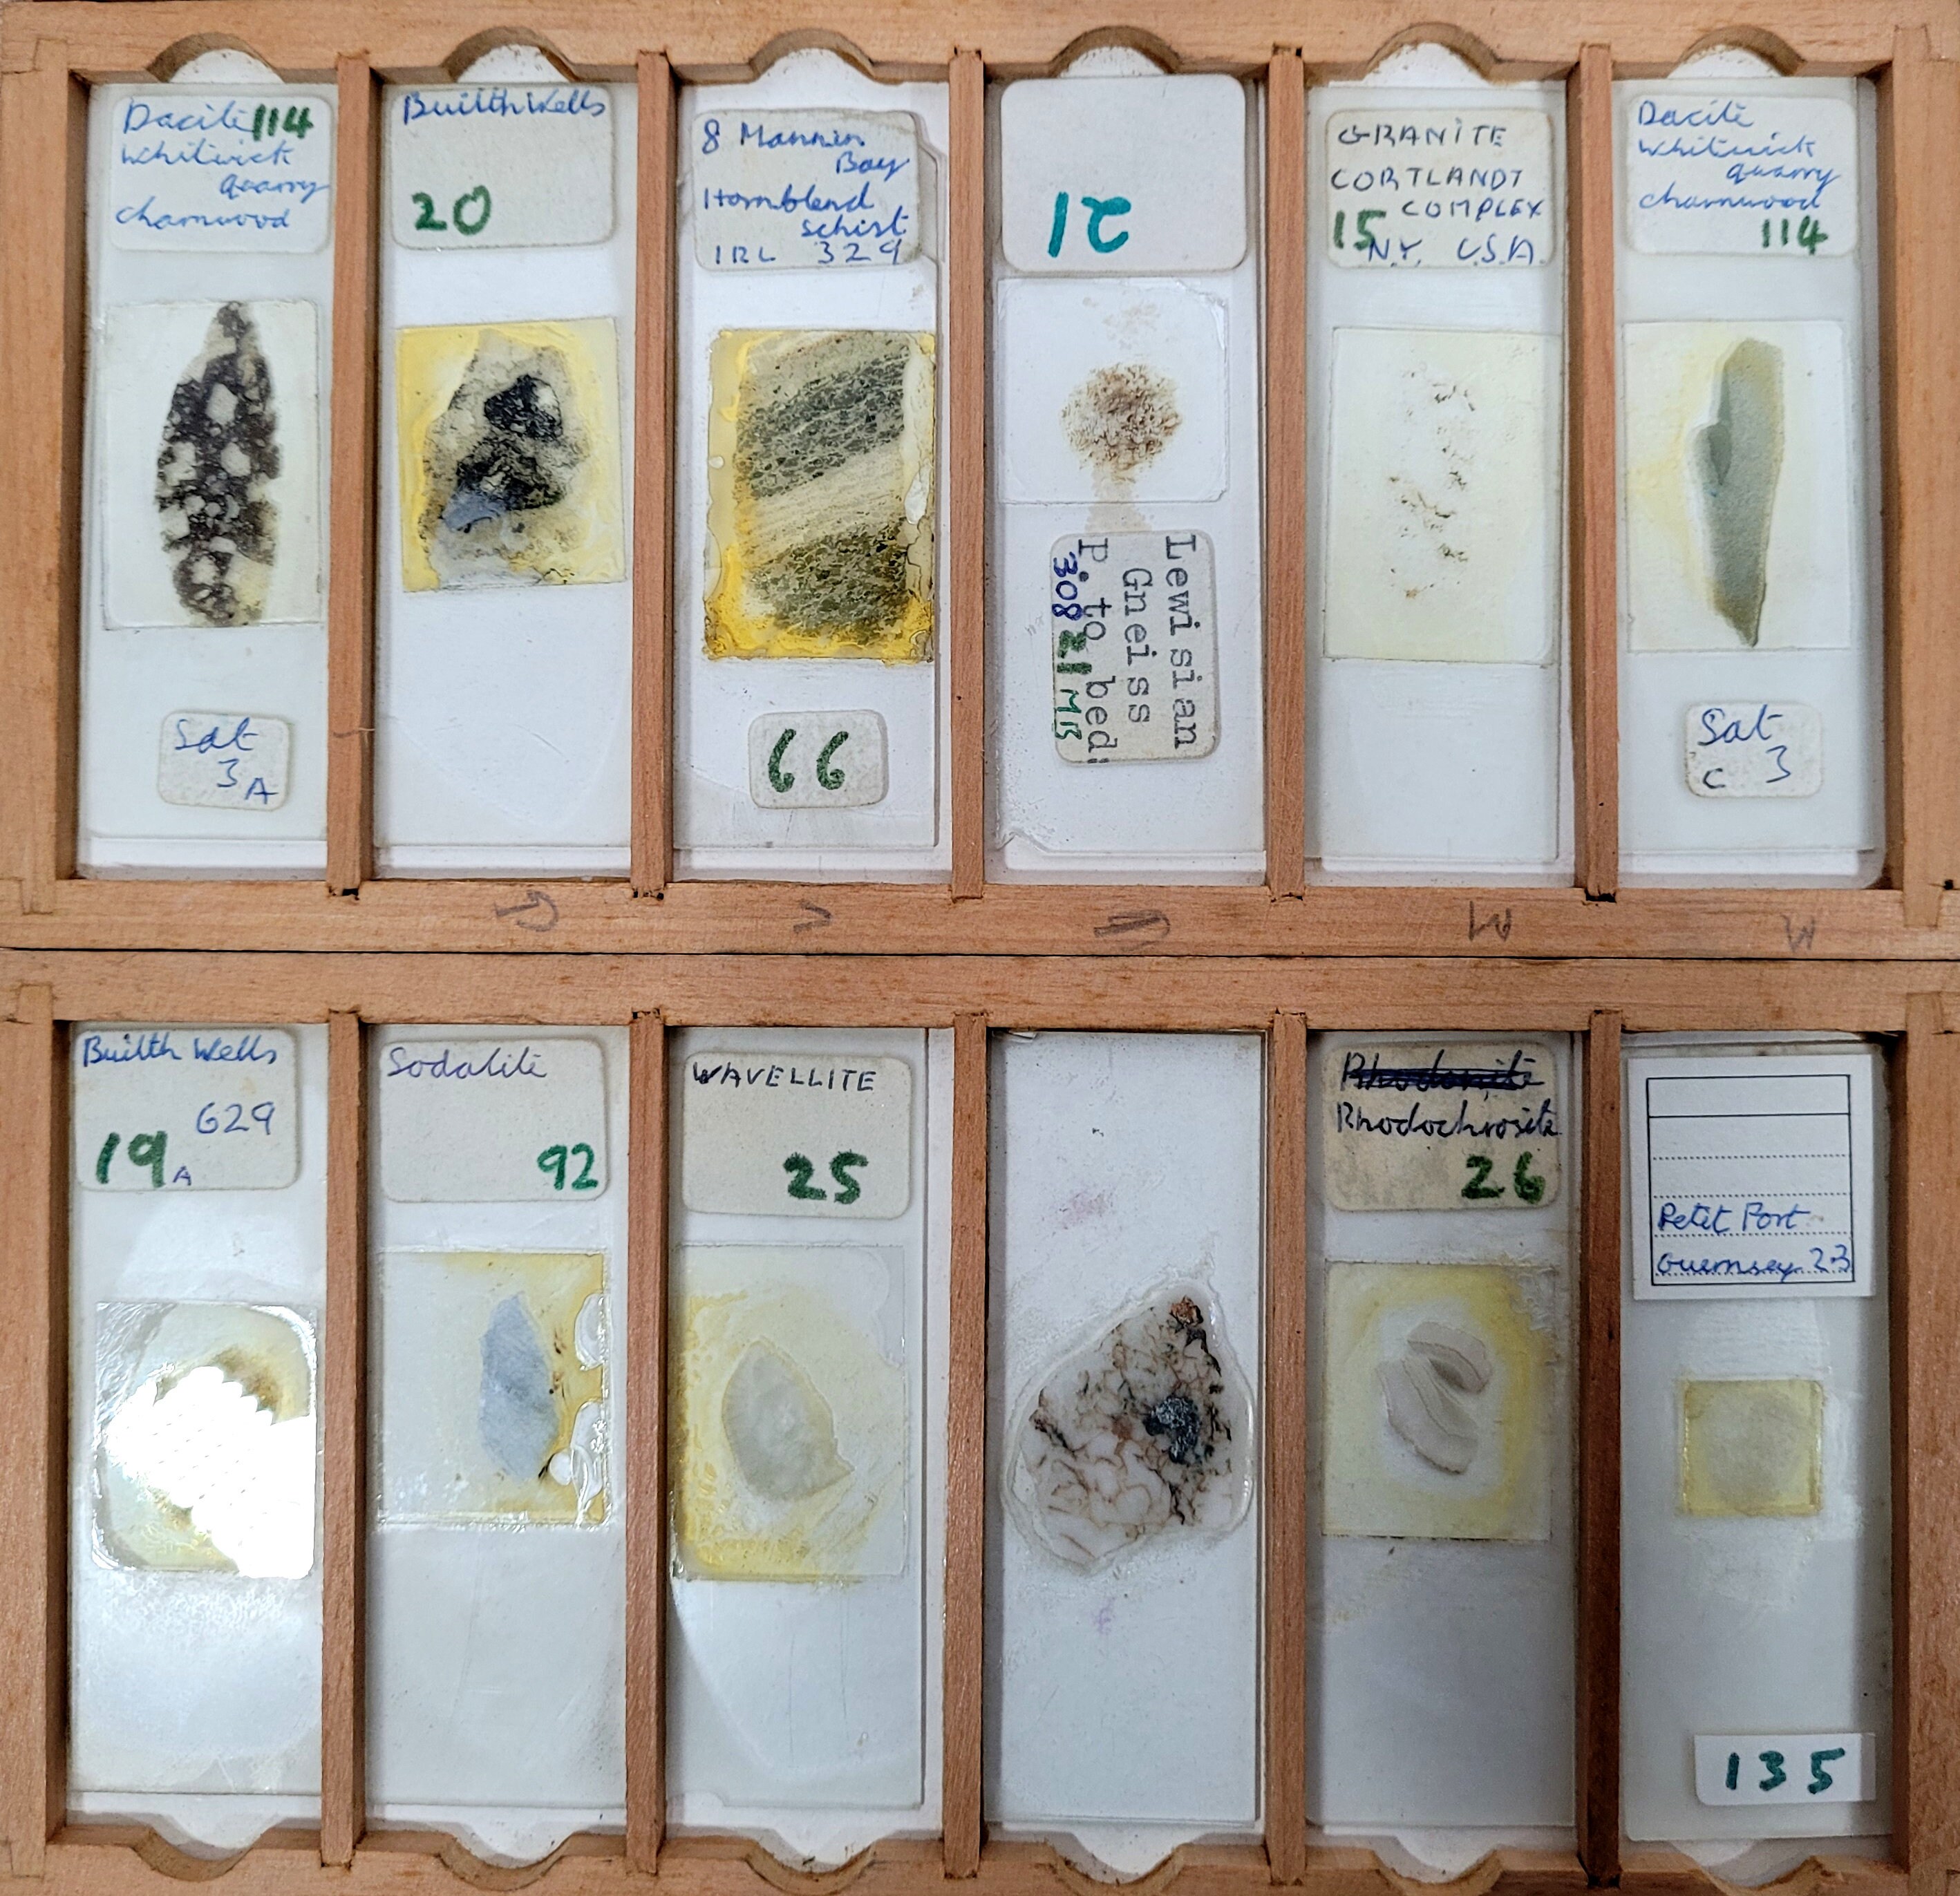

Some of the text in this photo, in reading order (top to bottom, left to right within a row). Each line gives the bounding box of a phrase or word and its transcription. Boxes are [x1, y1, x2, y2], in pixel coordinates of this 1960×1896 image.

[252, 104, 314, 142] 114
[701, 118, 720, 155] 8
[1338, 117, 1507, 148] GRANITE
[836, 150, 910, 182] Bay
[1331, 167, 1523, 191] CORTLANDT
[411, 184, 492, 236] 20
[1332, 209, 1386, 251] 15
[1402, 197, 1545, 222] COMPLEX
[816, 238, 903, 266] 329
[1762, 214, 1829, 256] 114
[1082, 597, 1113, 641] to
[1122, 567, 1158, 724] Gneiss
[1166, 533, 1203, 750] Lewisian
[194, 1034, 278, 1064] Wells
[692, 1061, 877, 1092] WAVELLITE
[536, 1142, 599, 1191] 92
[782, 1149, 869, 1205] 25
[1460, 1150, 1546, 1204] 26
[1725, 1747, 1846, 1795] 135
